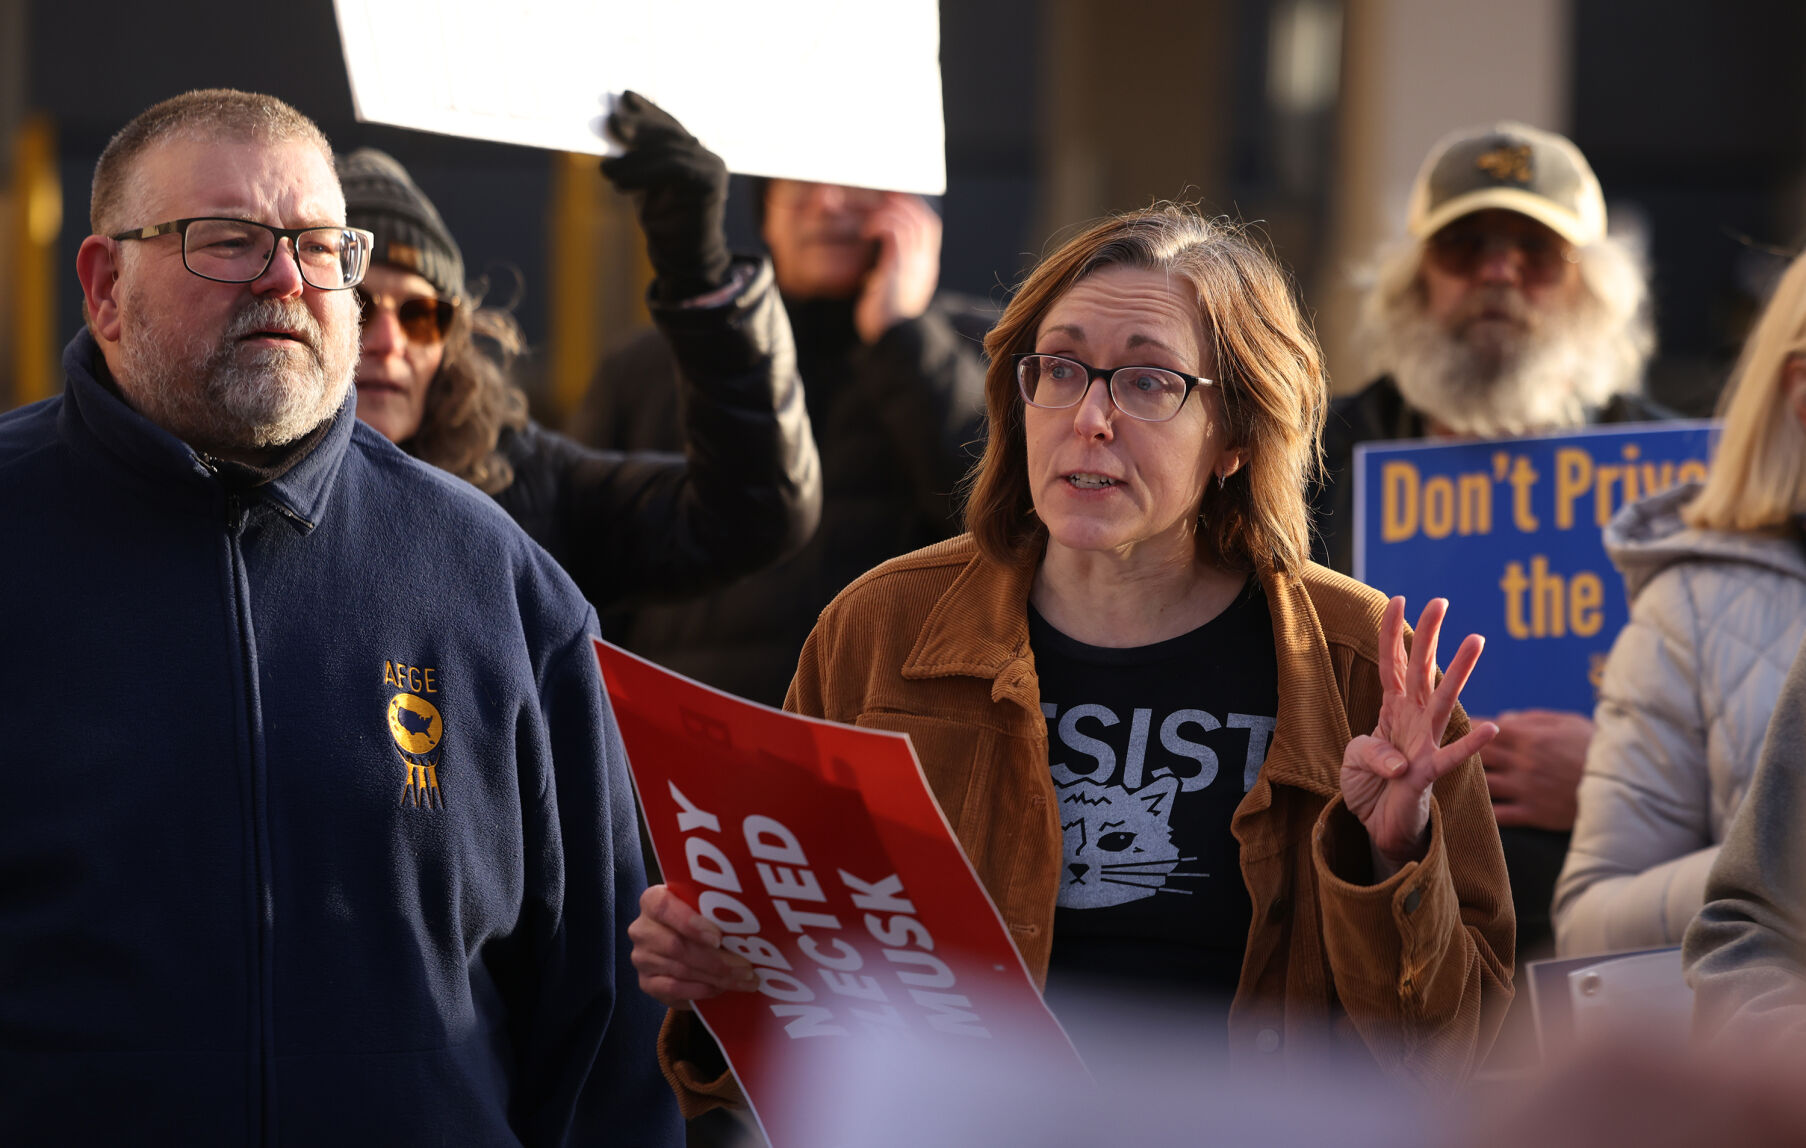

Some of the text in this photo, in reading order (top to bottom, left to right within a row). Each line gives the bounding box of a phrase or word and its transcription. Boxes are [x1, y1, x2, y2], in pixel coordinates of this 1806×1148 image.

[1382, 451, 1539, 542] Don't
[1500, 555, 1604, 640] the
[384, 660, 437, 693] AFGE
[1040, 702, 1277, 793] SIST
[668, 779, 849, 1039] NOBODY
[743, 814, 906, 1036] LECTED
[837, 868, 992, 1039] MUSK
